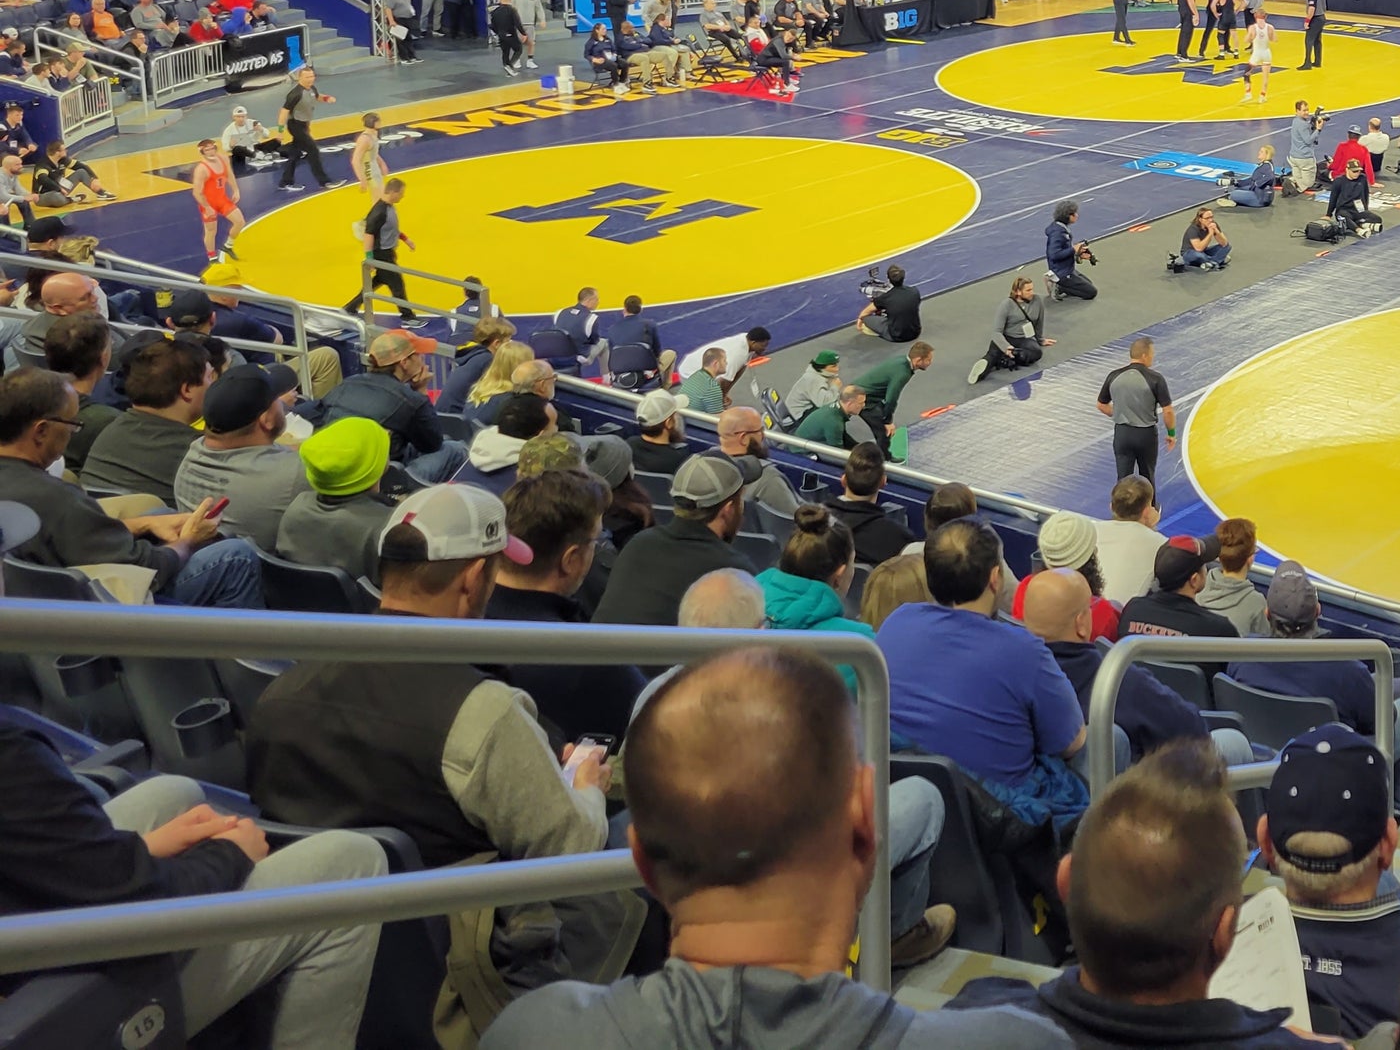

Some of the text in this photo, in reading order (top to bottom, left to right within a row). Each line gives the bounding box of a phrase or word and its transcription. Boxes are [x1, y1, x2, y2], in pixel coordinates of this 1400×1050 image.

[225, 51, 285, 75] UNITED AS
[1316, 958, 1343, 976] 1855
